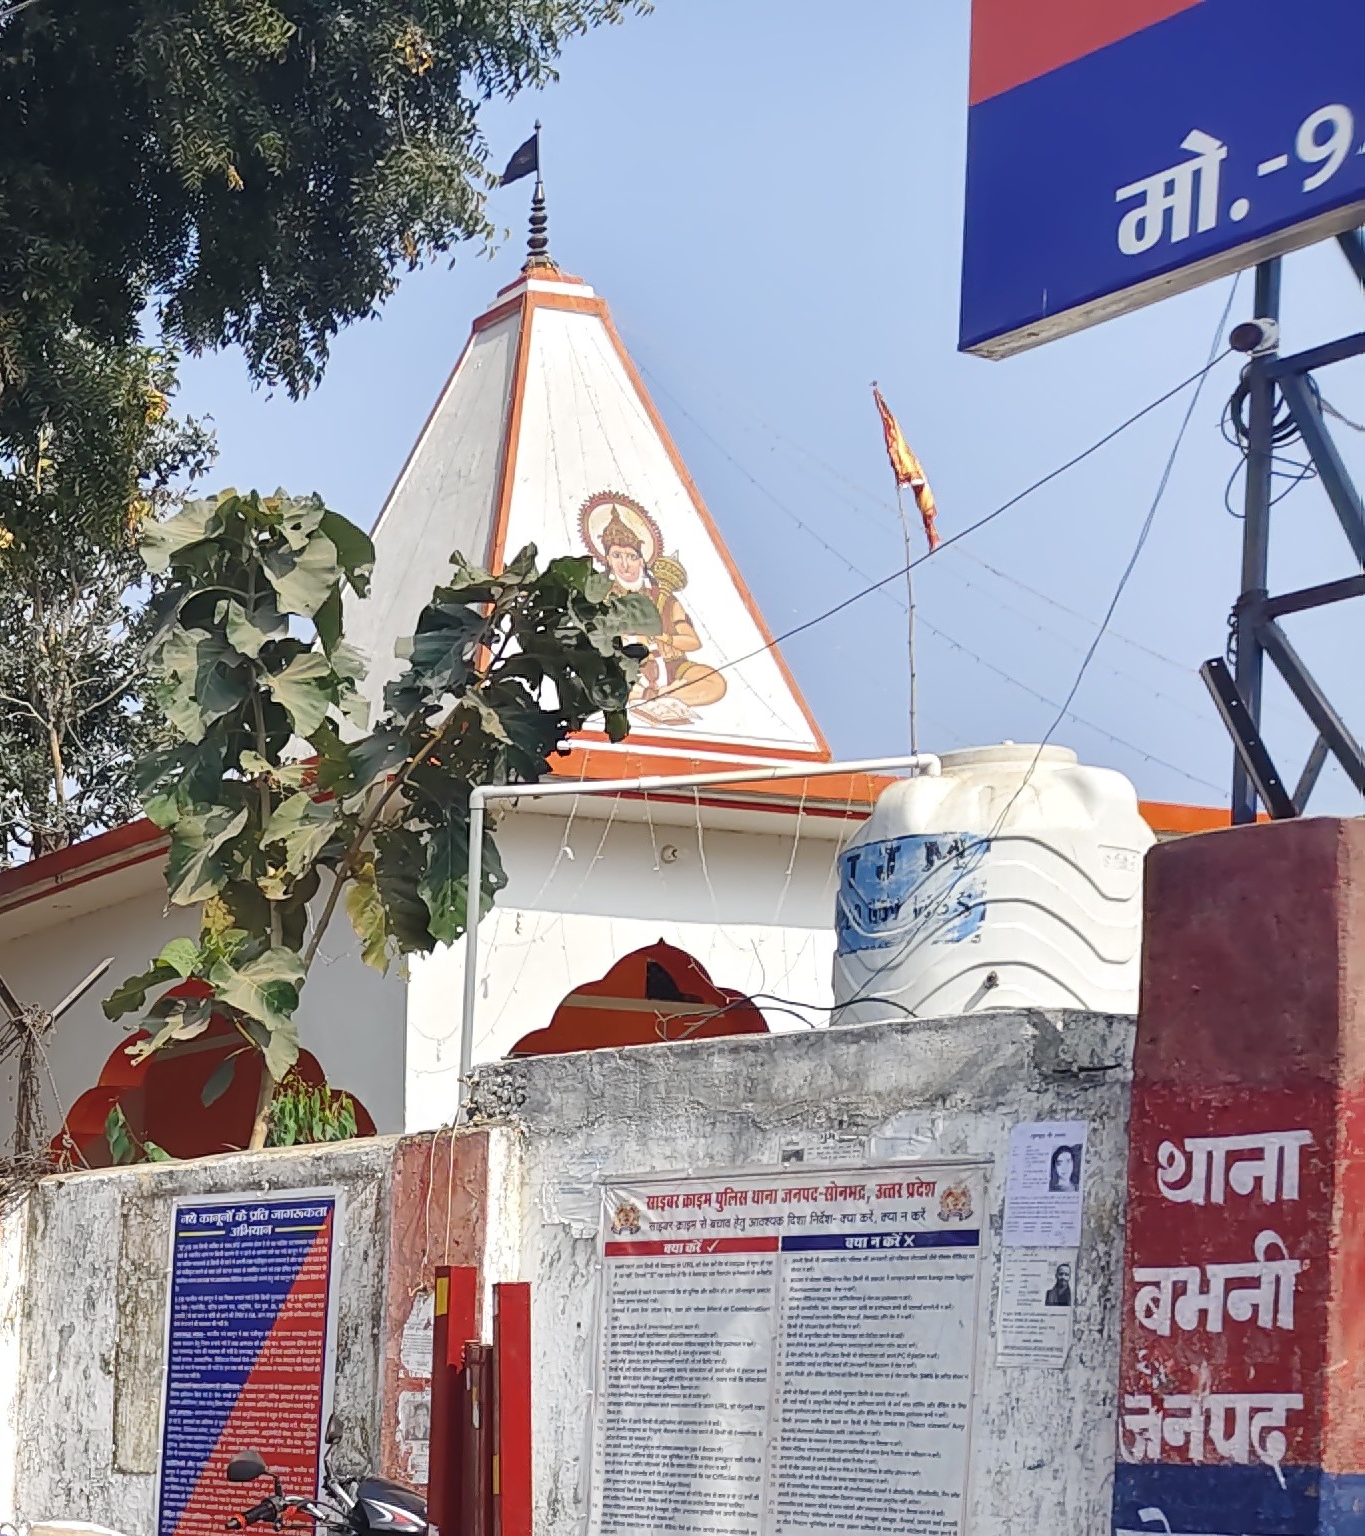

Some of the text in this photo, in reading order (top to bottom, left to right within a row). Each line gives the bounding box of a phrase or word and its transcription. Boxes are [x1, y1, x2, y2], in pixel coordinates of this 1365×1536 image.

[1115, 103, 1365, 256] मो.-9
[1156, 1129, 1313, 1206] थाना
[646, 1194, 681, 1212] साइबर
[682, 1192, 713, 1210] क्राइम
[715, 1186, 749, 1213] पुलिस
[751, 1189, 779, 1205] थाना
[875, 1182, 903, 1199] उत्तर
[906, 1176, 937, 1200] प्रदेश
[199, 1209, 233, 1227] कानूनों
[235, 1209, 248, 1222] के
[249, 1207, 269, 1222] प्रति
[229, 1224, 273, 1237] अभियान
[787, 1212, 807, 1227] दिशा
[840, 1213, 857, 1224] क्या
[880, 1211, 897, 1222] क्या
[900, 1211, 908, 1222] न
[910, 1206, 926, 1222] करें
[663, 1243, 684, 1254] क्या
[845, 1232, 902, 1249] क्या न करें
[1133, 1229, 1303, 1336] बभनी
[1117, 1392, 1304, 1490] जनपद
